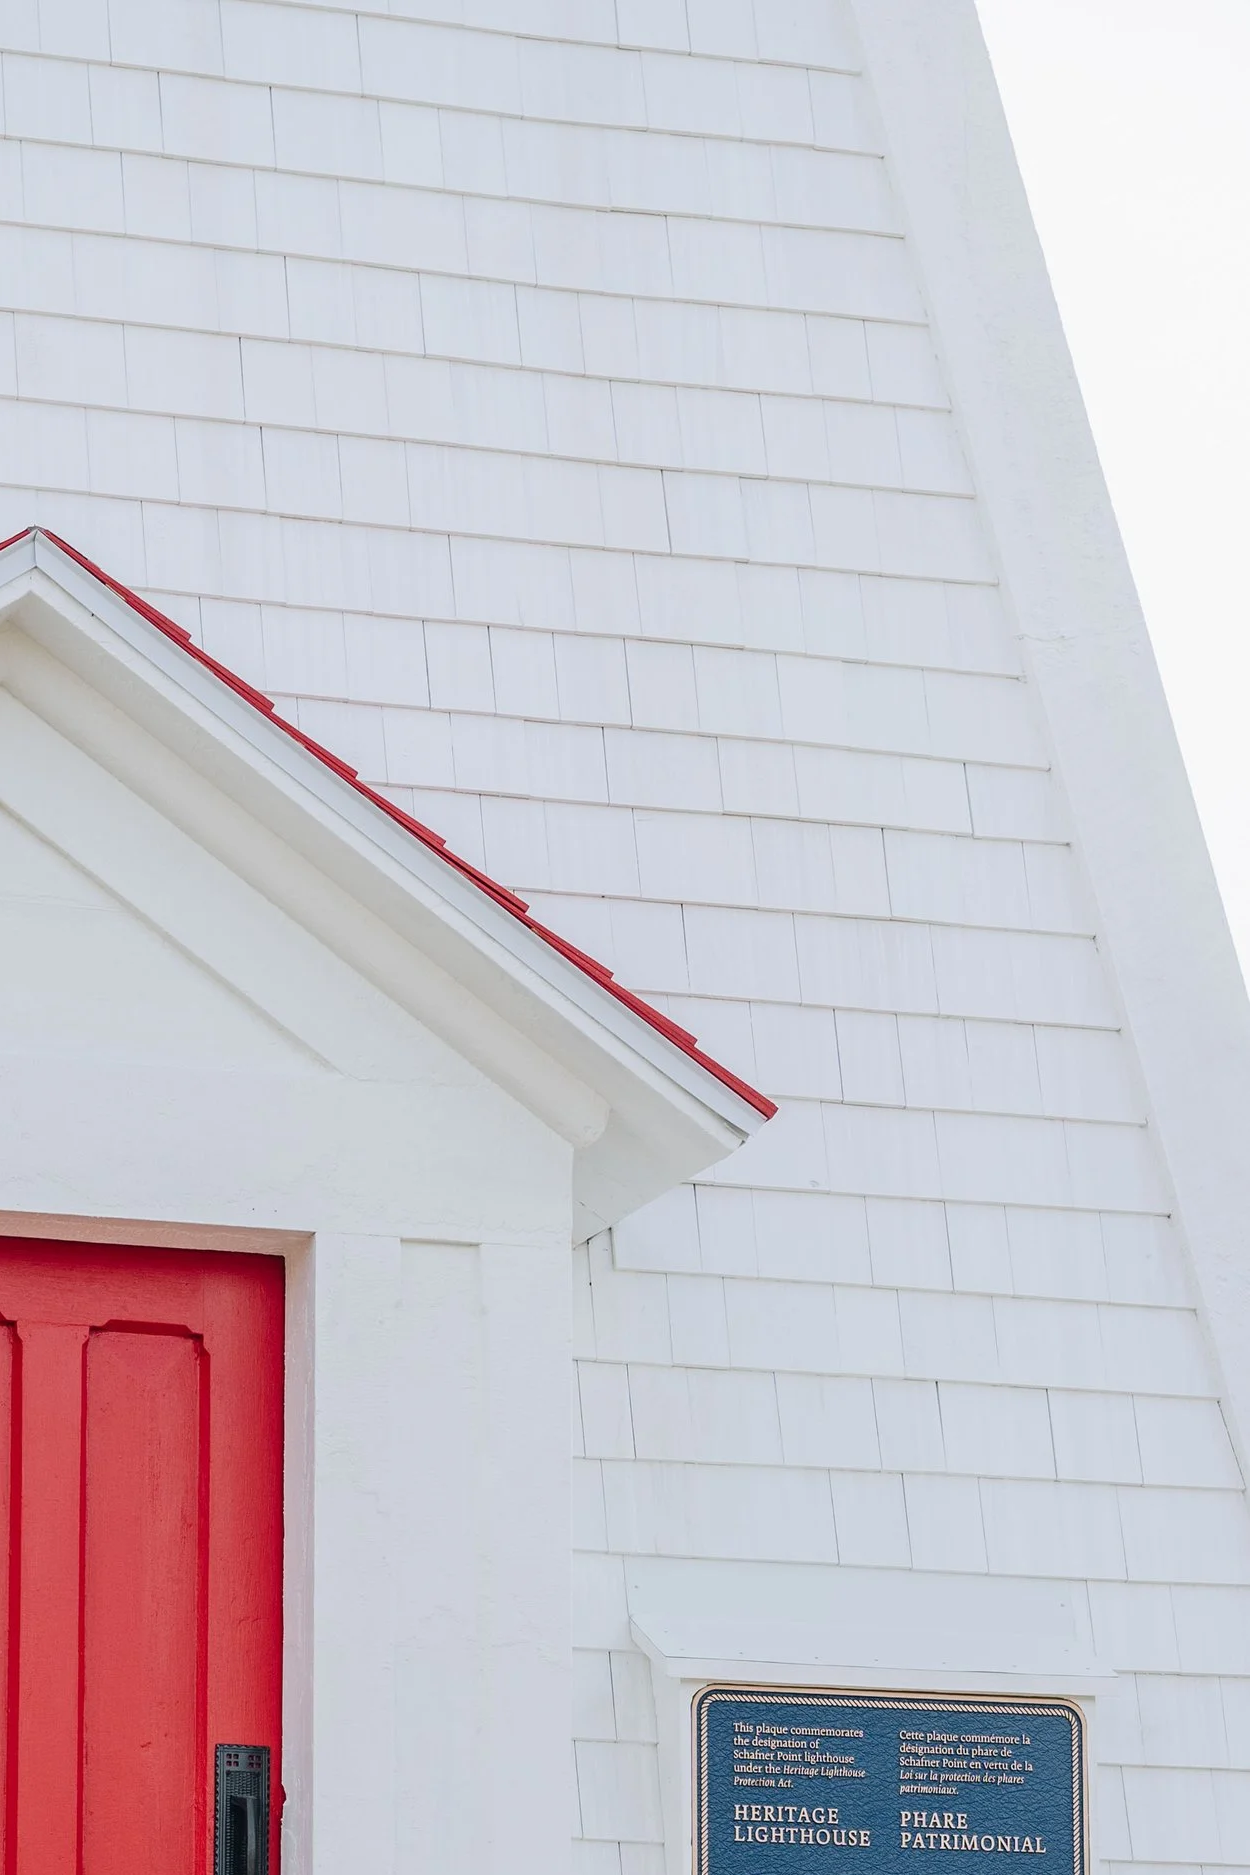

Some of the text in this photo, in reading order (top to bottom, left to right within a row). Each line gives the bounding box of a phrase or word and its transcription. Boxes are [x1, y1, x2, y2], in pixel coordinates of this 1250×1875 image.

[733, 1722, 864, 1738] This plaque commemorates
[899, 1730, 1031, 1745] Cette plaque commémore la
[733, 1735, 820, 1750] the designation of
[733, 1750, 855, 1764] Schafner Point lighthouse
[899, 1743, 1012, 1758] désignation du phare de
[734, 1763, 866, 1779] under the Heritage Lighthouse
[899, 1756, 1033, 1771] Schafner Point en vertu de la
[734, 1776, 794, 1788] Protection Act.
[900, 1770, 1025, 1785] Loi sur la protection des phares
[900, 1784, 959, 1796] patrimoniaux.
[734, 1804, 839, 1824] HERITAGE
[900, 1811, 968, 1830] PHARE
[734, 1825, 871, 1847] LIGHTHOUSE
[900, 1832, 1047, 1853] PATRIMONIAL
